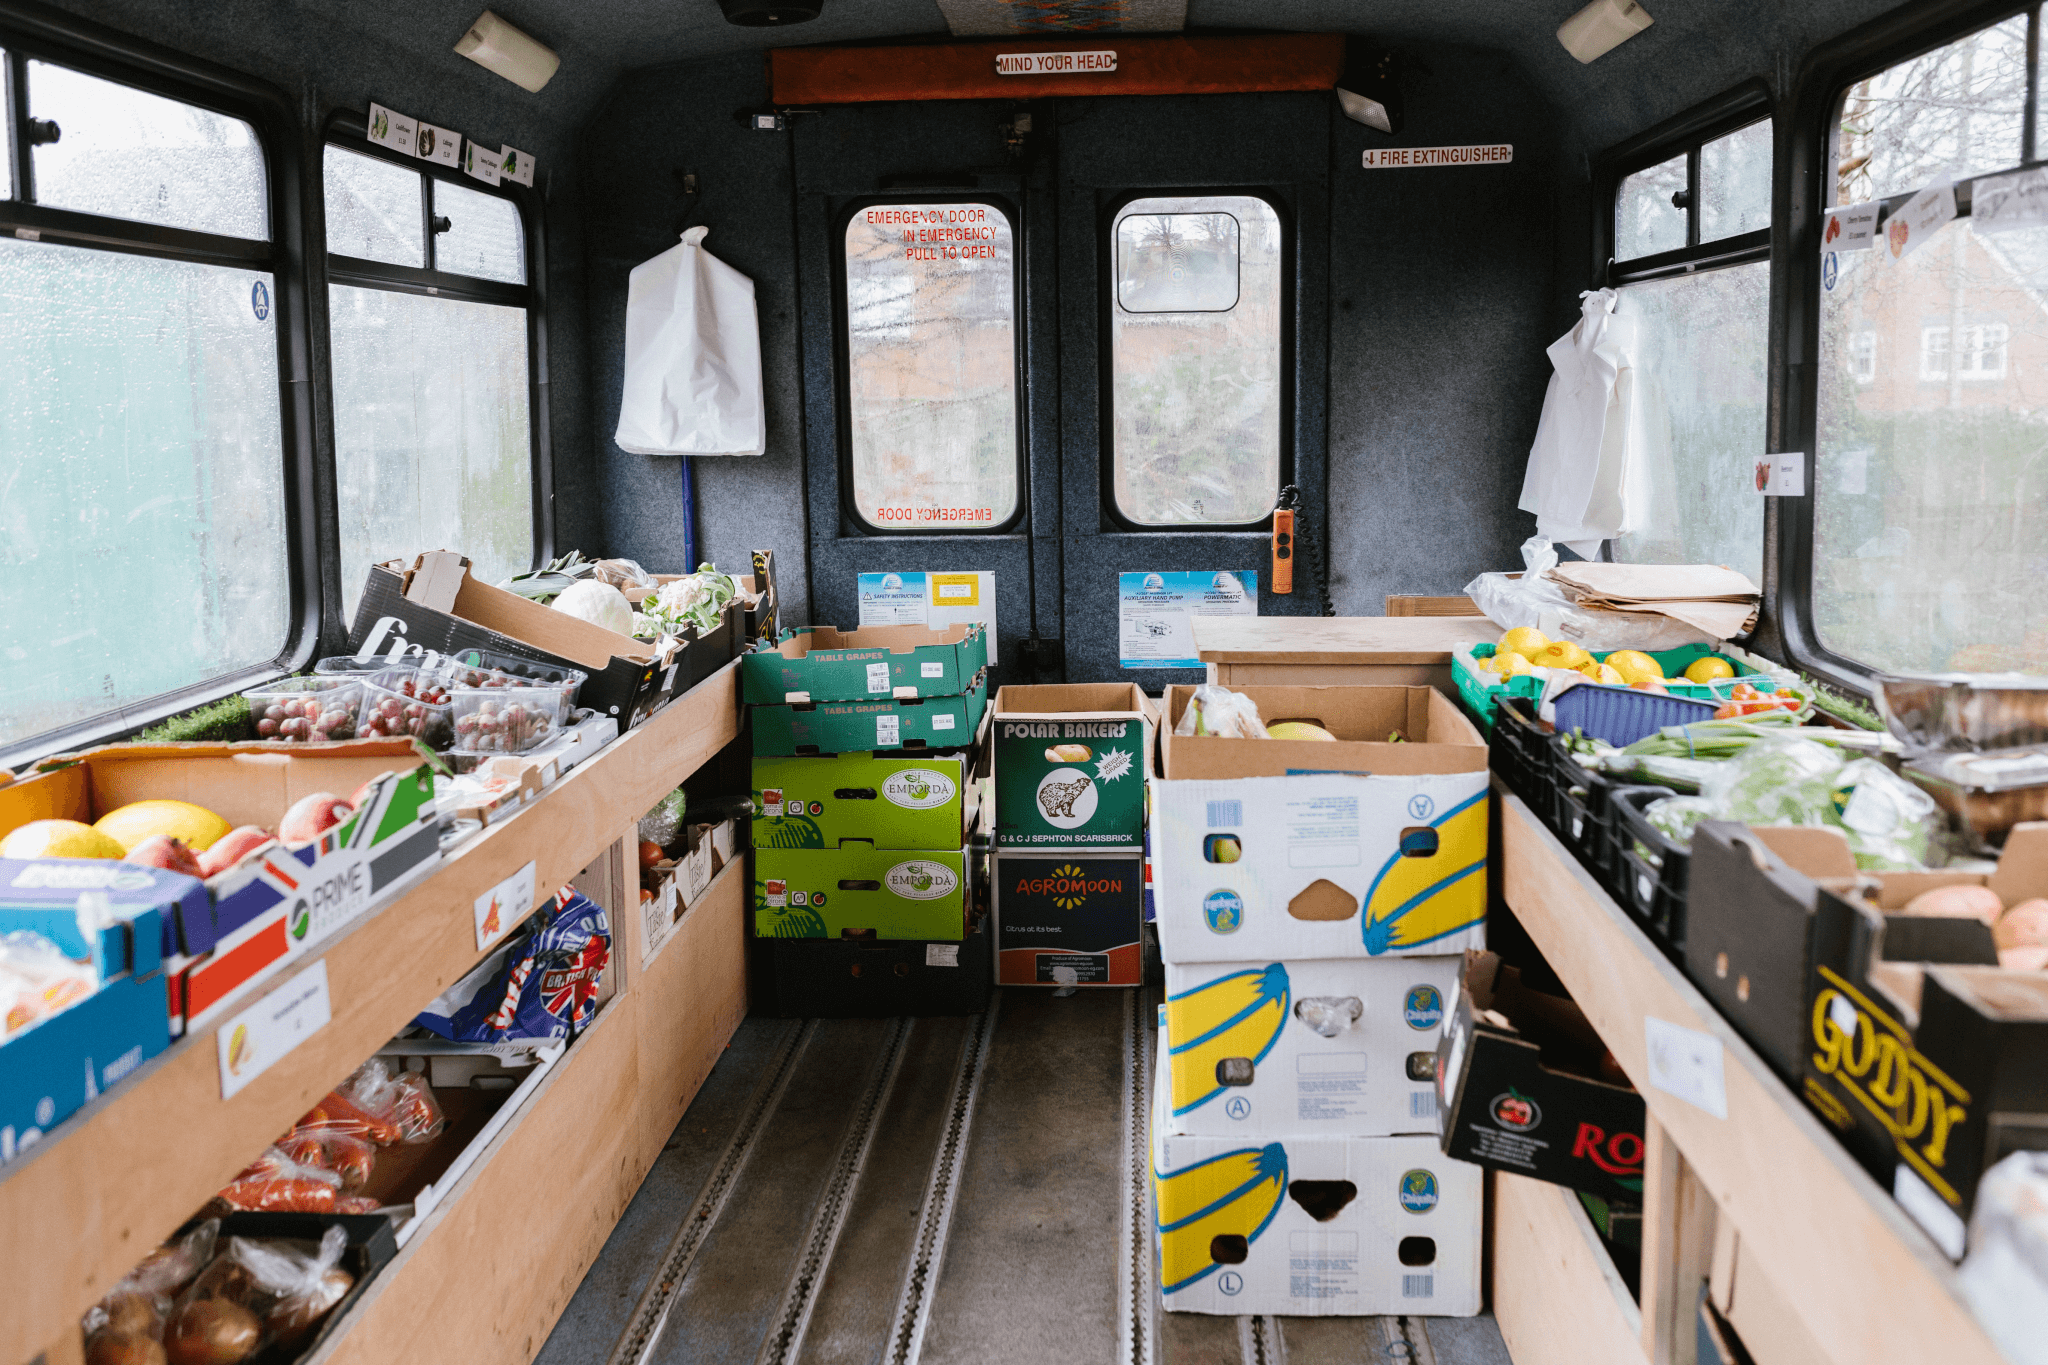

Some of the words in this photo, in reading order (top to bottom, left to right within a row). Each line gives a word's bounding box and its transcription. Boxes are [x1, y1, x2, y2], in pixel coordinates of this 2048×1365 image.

[1000, 57, 1032, 71] MIND
[1037, 56, 1072, 70] YOUR
[1078, 54, 1113, 69] HEAD
[1380, 151, 1408, 165] FIRE
[1413, 146, 1508, 164] EXTINGUISHER
[867, 210, 944, 224] EMERGENCY
[949, 209, 985, 222] DOOR
[903, 229, 915, 242] IN
[920, 226, 996, 242] EMERGENCY
[906, 248, 937, 261] PULL
[941, 246, 957, 260] TO
[961, 245, 996, 259] OPEN
[814, 654, 844, 662] TABLE
[846, 652, 883, 661] GRAPES
[824, 706, 853, 715] TABLE
[855, 704, 893, 713] GRAPES
[1004, 723, 1060, 738] POLAR
[1064, 722, 1128, 738] BAKERS
[1102, 753, 1124, 771] WEIGHT
[1105, 757, 1128, 775] GRADED
[1074, 834, 1133, 842] SCARISBRICK
[313, 860, 362, 918] PRIME
[546, 969, 588, 988] BRITISH
[1405, 1010, 1442, 1023] Chiquita
[1232, 1099, 1244, 1114] A
[1225, 1276, 1236, 1291] L
